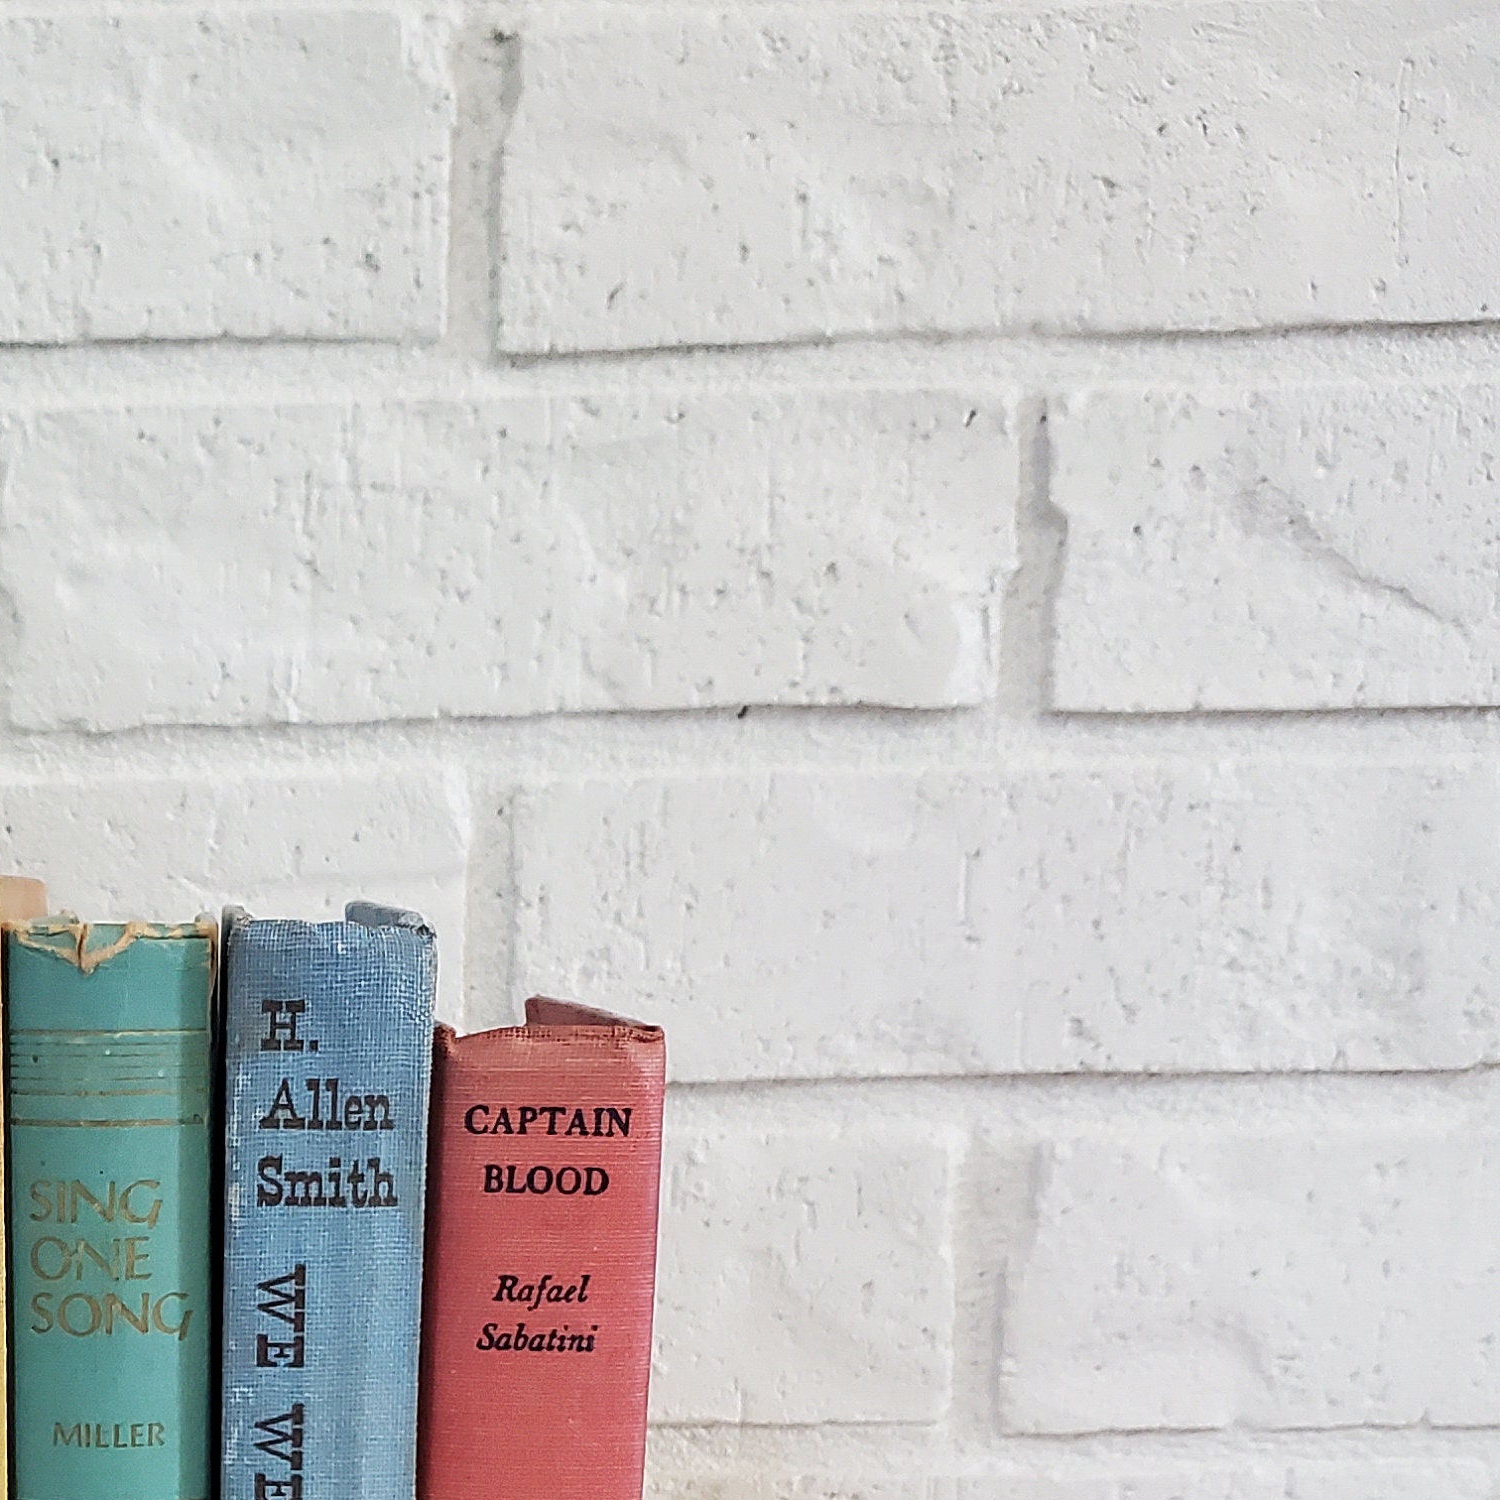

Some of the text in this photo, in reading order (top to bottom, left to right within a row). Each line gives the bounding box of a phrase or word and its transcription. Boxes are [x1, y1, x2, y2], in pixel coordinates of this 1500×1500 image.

[260, 999, 319, 1051] H.
[258, 1077, 395, 1131] Allen
[464, 1104, 632, 1137] CAPTAIN
[257, 1153, 398, 1208] Smith
[483, 1165, 610, 1195] BLOOD
[29, 1179, 163, 1229] SING
[30, 1236, 152, 1281] ONE
[256, 1264, 306, 1368] WE
[492, 1274, 591, 1311] Rafael
[31, 1292, 193, 1341] SONG
[476, 1323, 598, 1352] Sabatini
[53, 1421, 165, 1449] MILLER
